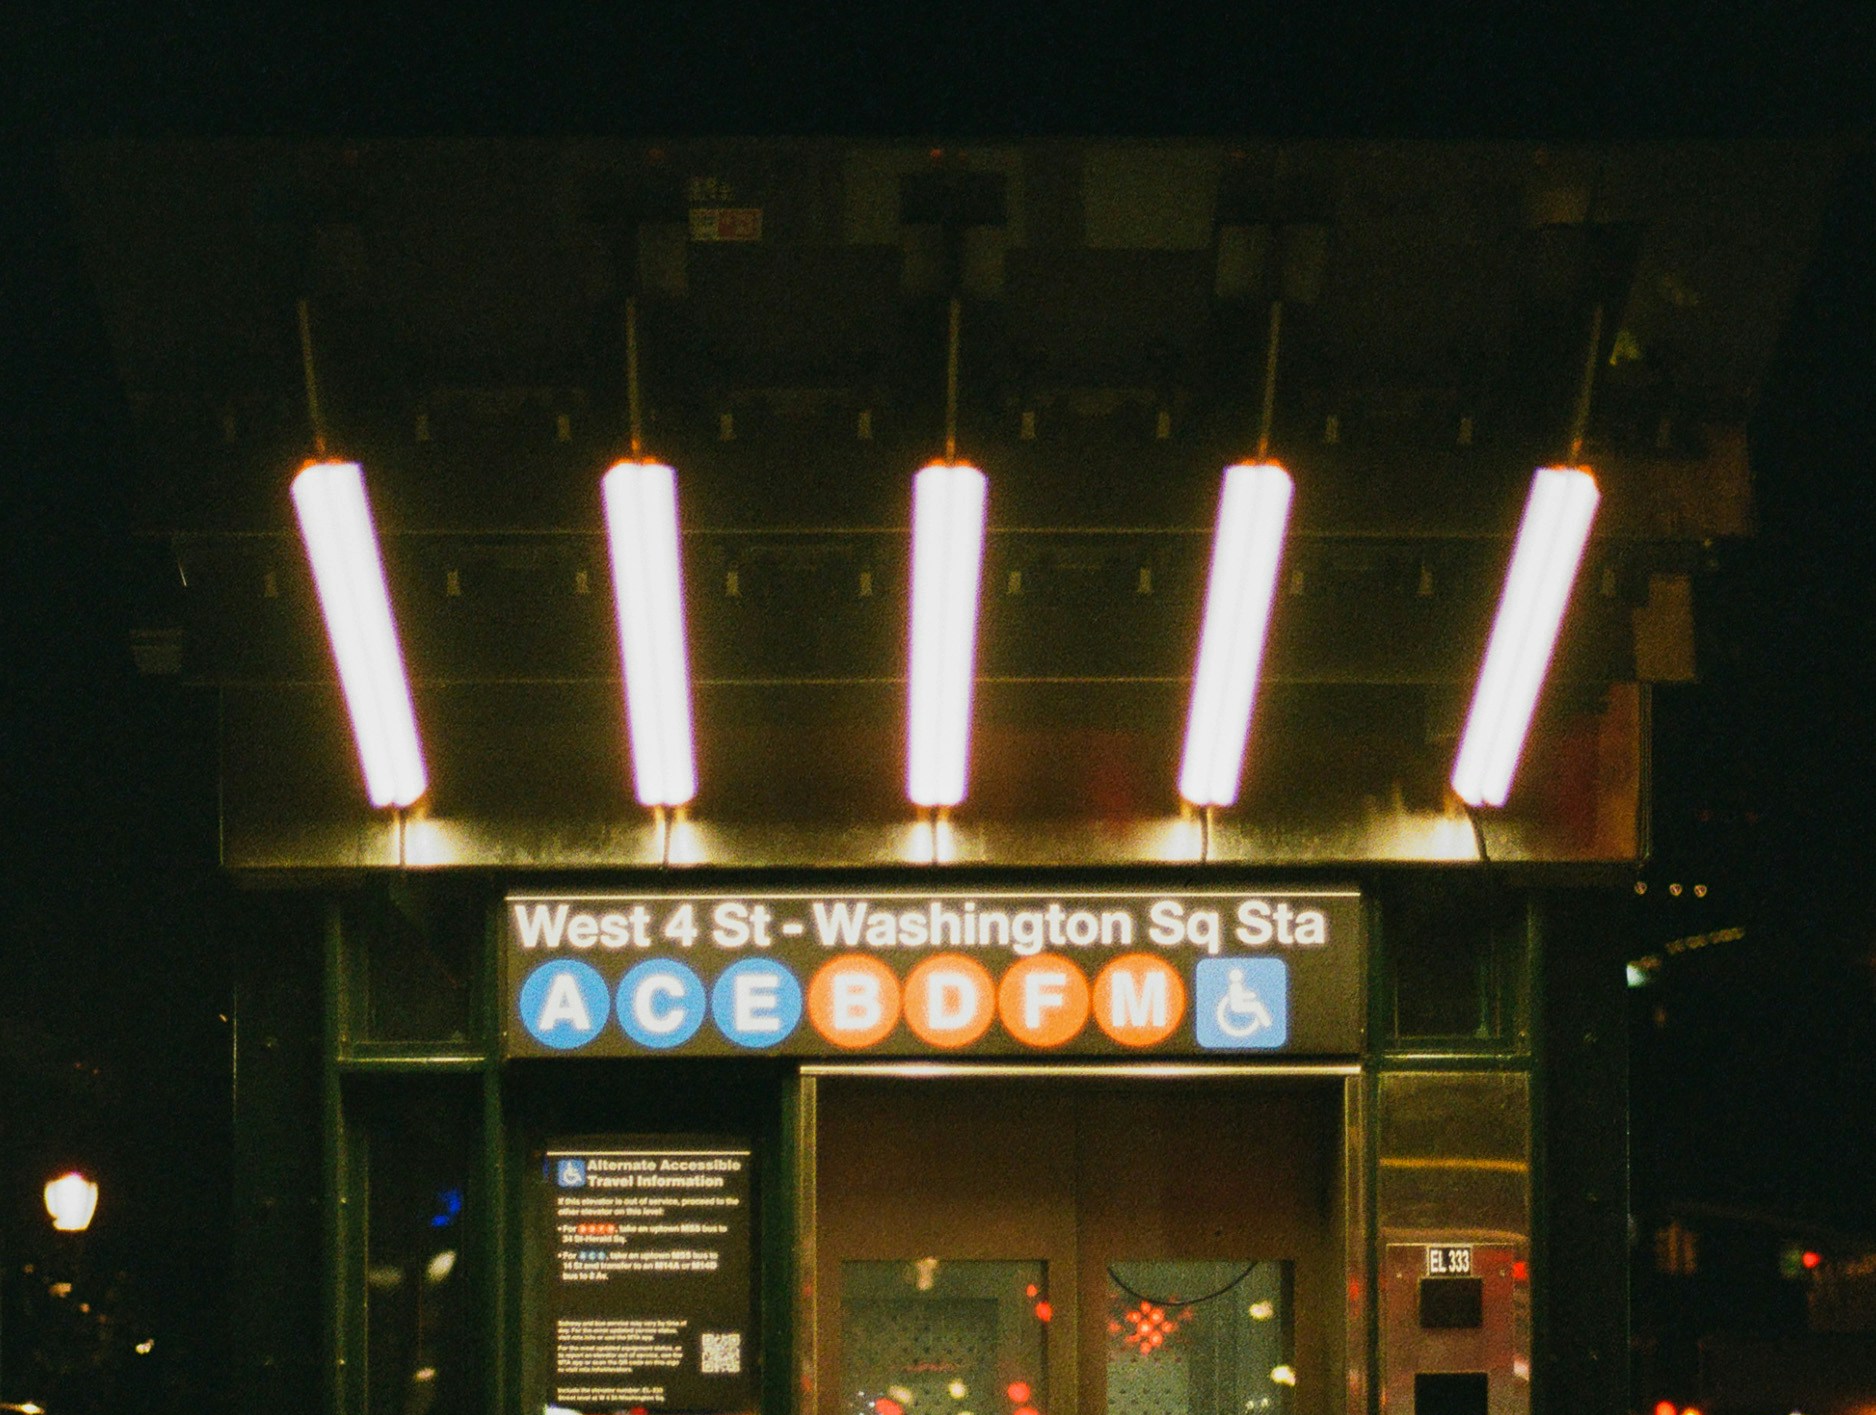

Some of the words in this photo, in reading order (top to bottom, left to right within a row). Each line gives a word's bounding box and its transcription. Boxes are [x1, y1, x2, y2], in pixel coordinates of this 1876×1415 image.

[515, 905, 650, 949] West
[663, 905, 698, 949] 4
[713, 905, 772, 949] St
[813, 903, 1132, 956] Washington
[1148, 904, 1221, 954] Sq
[1234, 905, 1326, 949] Sta
[538, 975, 593, 1031] A
[631, 975, 684, 1031] C
[734, 975, 780, 1031] E
[833, 975, 881, 1031] B
[929, 975, 975, 1031] D
[1025, 975, 1067, 1031] F
[1110, 975, 1167, 1031] M
[587, 1160, 657, 1171] Alternate
[660, 1160, 741, 1171] Accessible
[587, 1174, 634, 1187] Travel
[637, 1174, 724, 1187] Information
[1430, 1250, 1447, 1273] EL
[1449, 1250, 1470, 1273] 333
